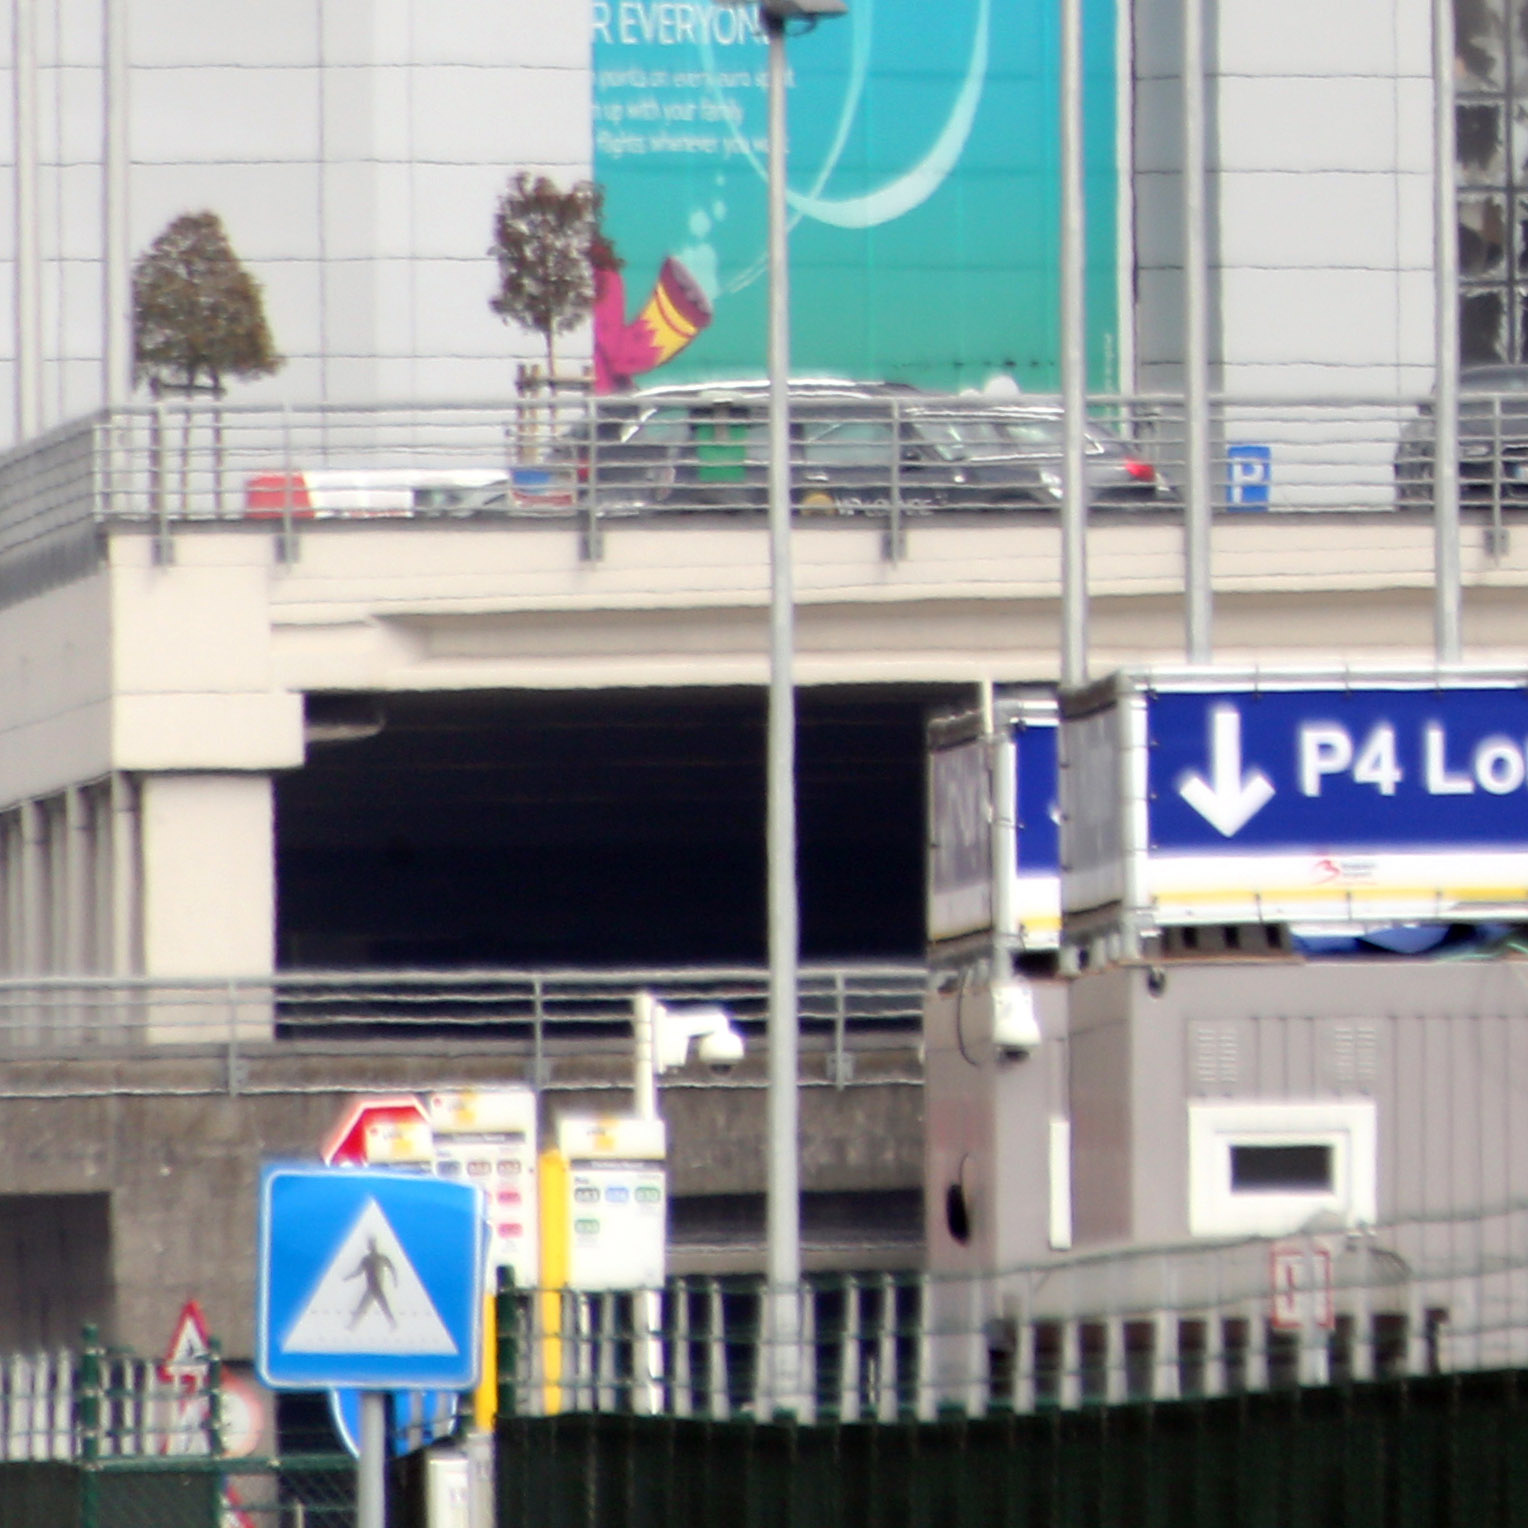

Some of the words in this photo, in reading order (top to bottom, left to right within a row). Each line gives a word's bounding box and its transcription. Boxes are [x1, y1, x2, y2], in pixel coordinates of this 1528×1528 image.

[619, 0, 772, 46] EVERYON
[1233, 457, 1265, 506] P
[1298, 719, 1404, 798] P4
